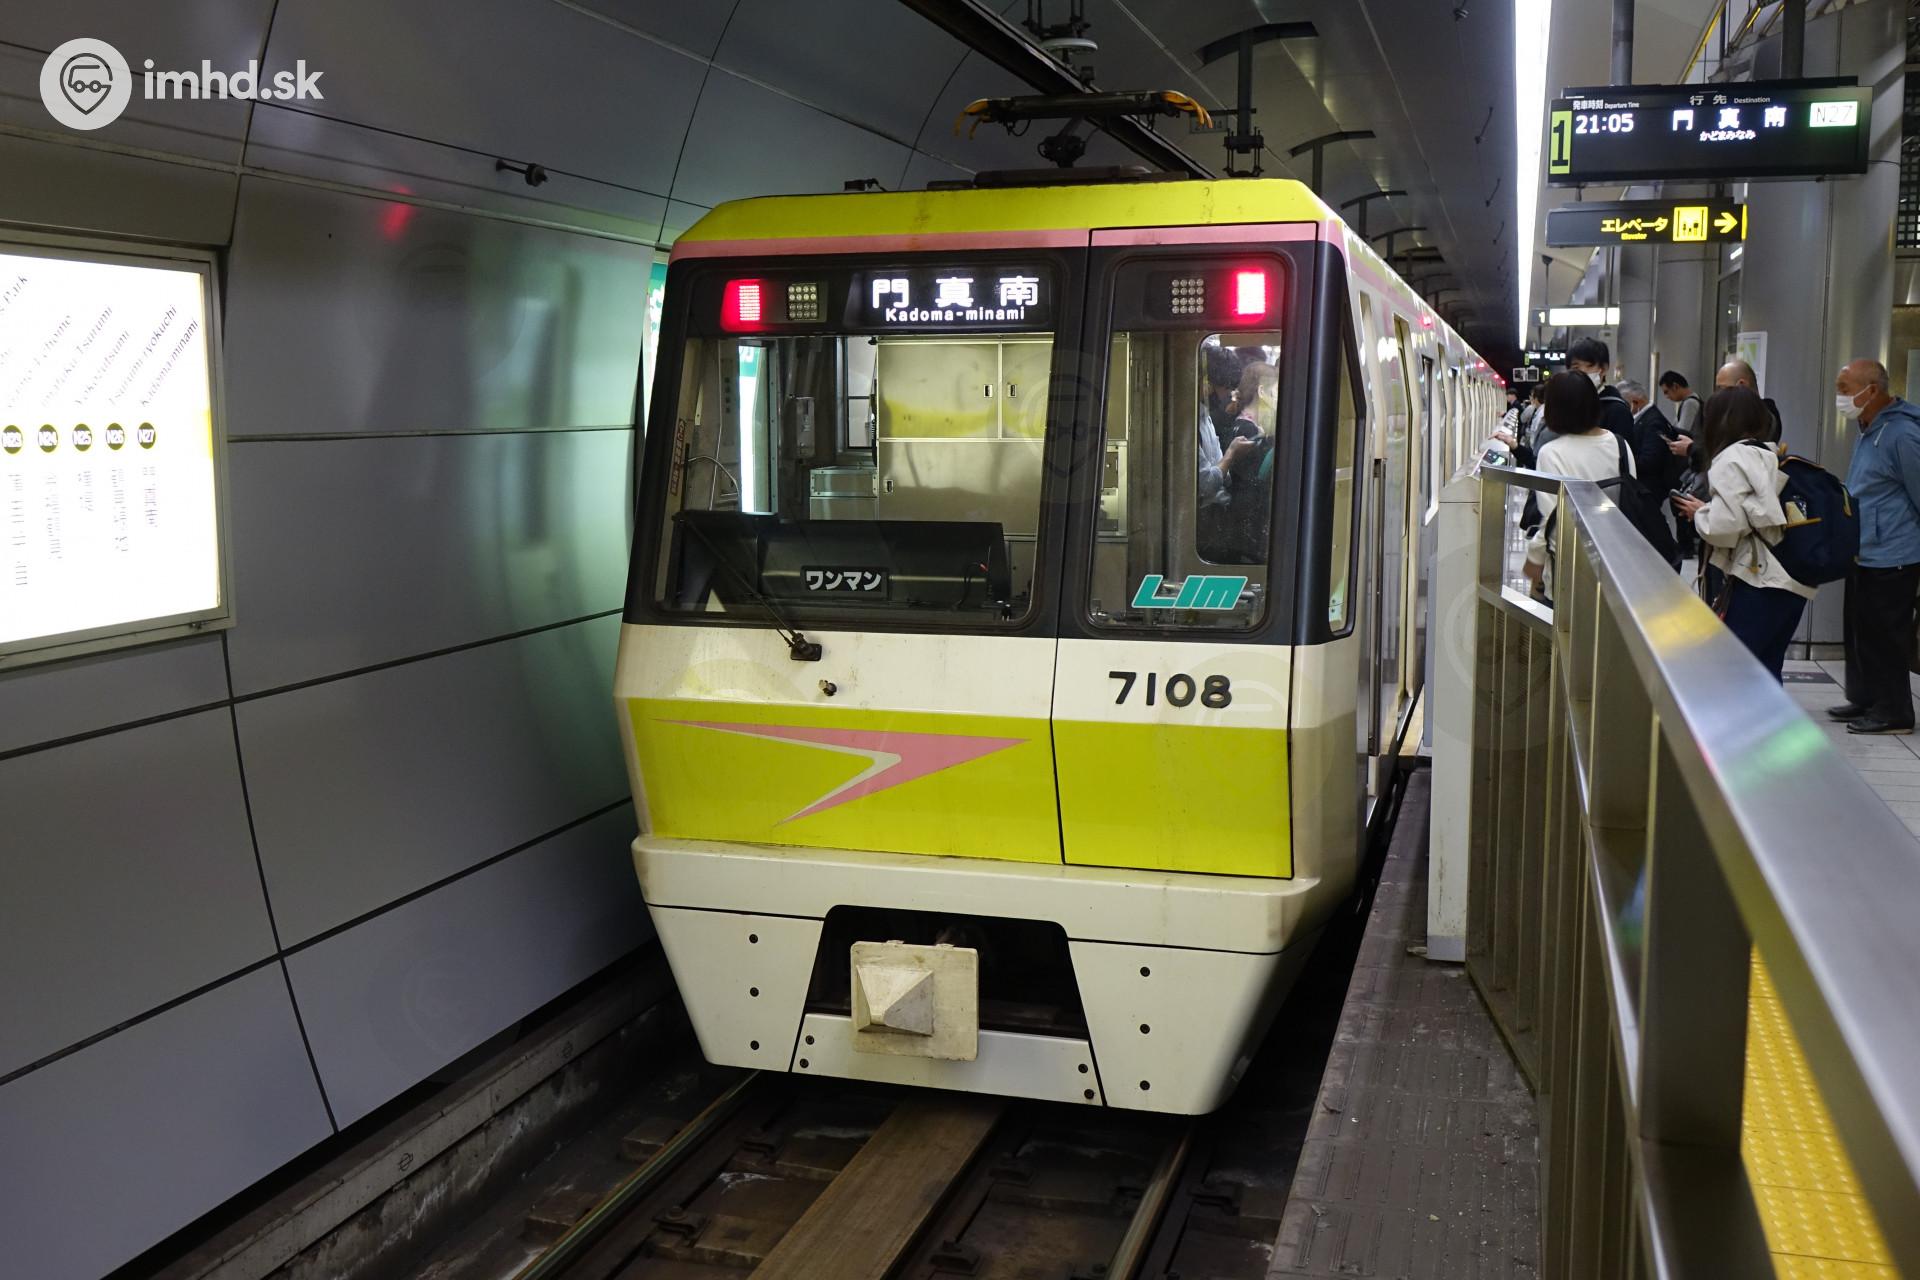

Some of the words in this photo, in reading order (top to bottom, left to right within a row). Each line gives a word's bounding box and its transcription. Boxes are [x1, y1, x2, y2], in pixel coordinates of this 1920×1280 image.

[1733, 95, 1771, 105] Destination
[1575, 113, 1634, 134] 21:05
[1815, 104, 1854, 124] N27
[1552, 119, 1569, 167] 1
[1600, 217, 1669, 233] エレベータ
[872, 275, 1040, 309] 門真南
[886, 306, 1025, 322] Kadoma-minami
[1538, 311, 1546, 324] 1
[805, 569, 882, 592] ワンマン
[1131, 573, 1249, 610] LIM
[1108, 670, 1233, 710] 7108
